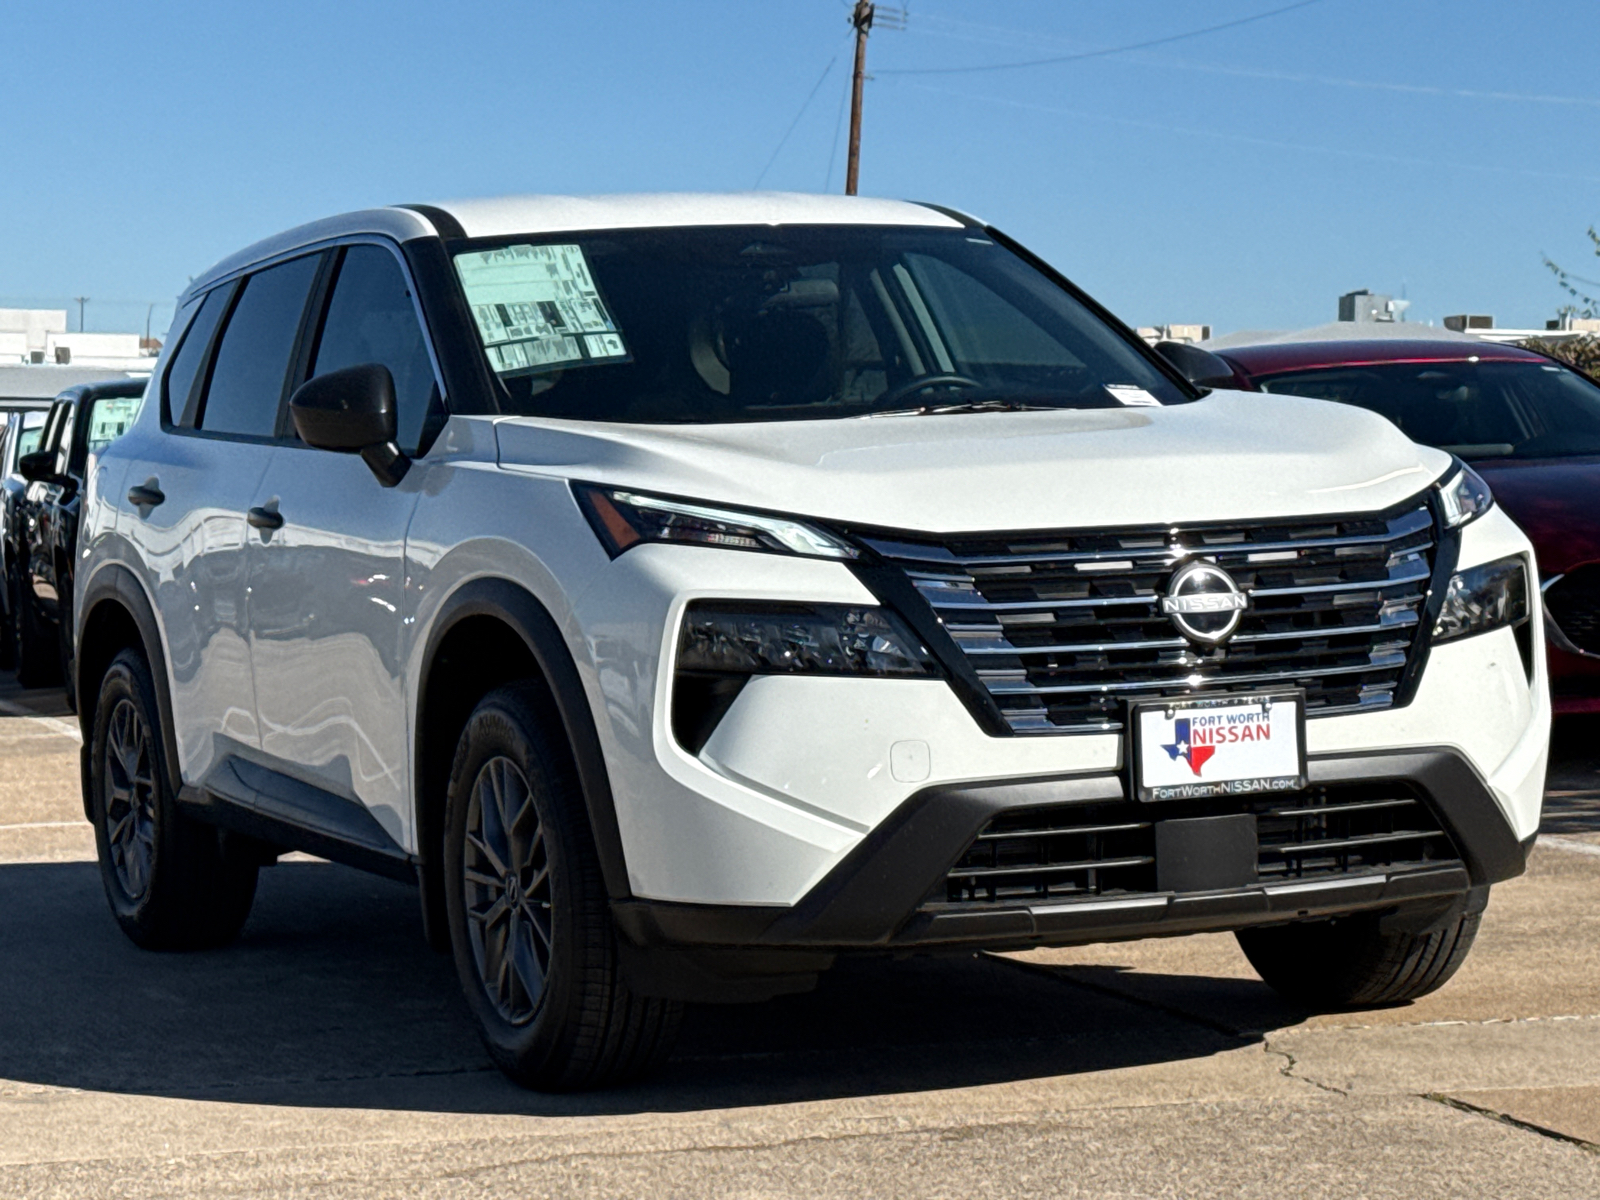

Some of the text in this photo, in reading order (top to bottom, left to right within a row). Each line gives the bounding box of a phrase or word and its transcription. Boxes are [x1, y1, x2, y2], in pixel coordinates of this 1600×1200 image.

[1165, 594, 1246, 612] NISSAN
[1169, 696, 1271, 710] FORT WORTH TEXAS
[1193, 713, 1270, 727] FORT WORTH
[1193, 724, 1271, 745] NISSAN
